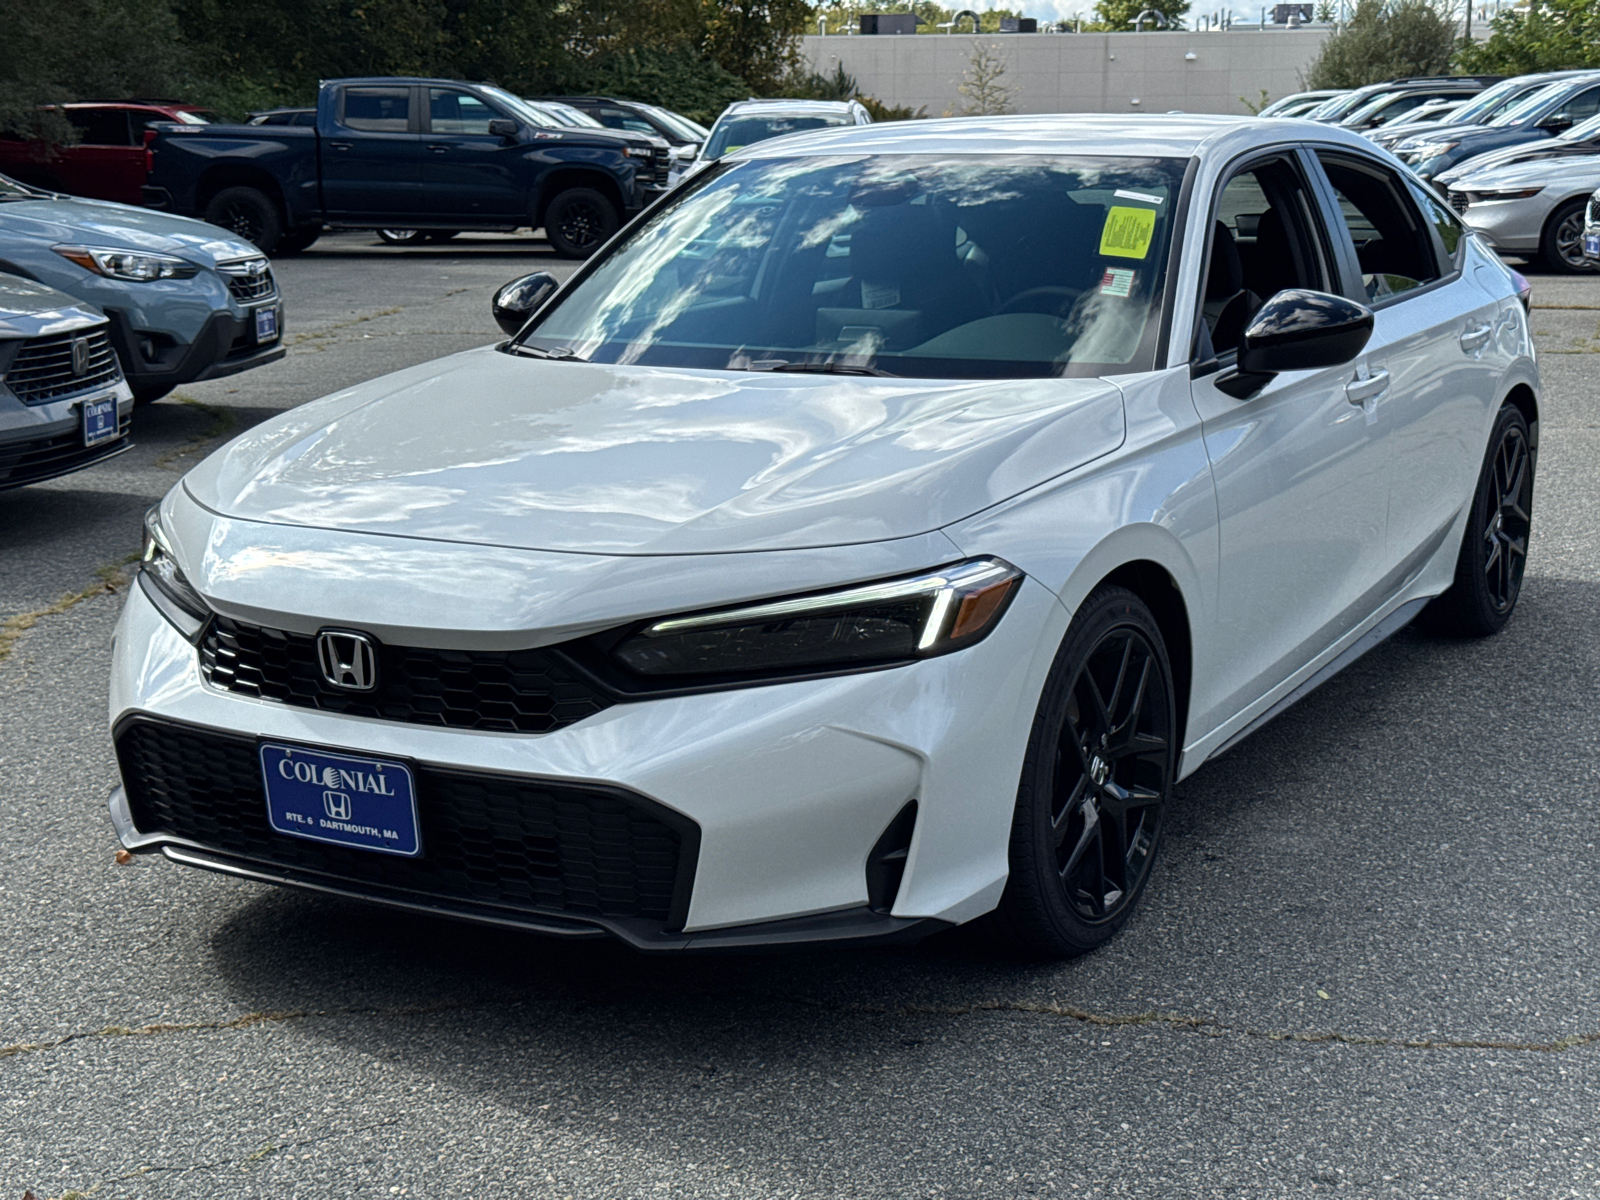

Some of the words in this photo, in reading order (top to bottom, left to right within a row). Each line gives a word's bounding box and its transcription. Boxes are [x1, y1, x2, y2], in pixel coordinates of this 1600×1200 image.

[278, 758, 395, 796] COLONIAL
[285, 812, 306, 824] RTE.
[307, 816, 314, 825] 6
[319, 819, 382, 839] DARTMOUTH,
[383, 829, 399, 840] MA
